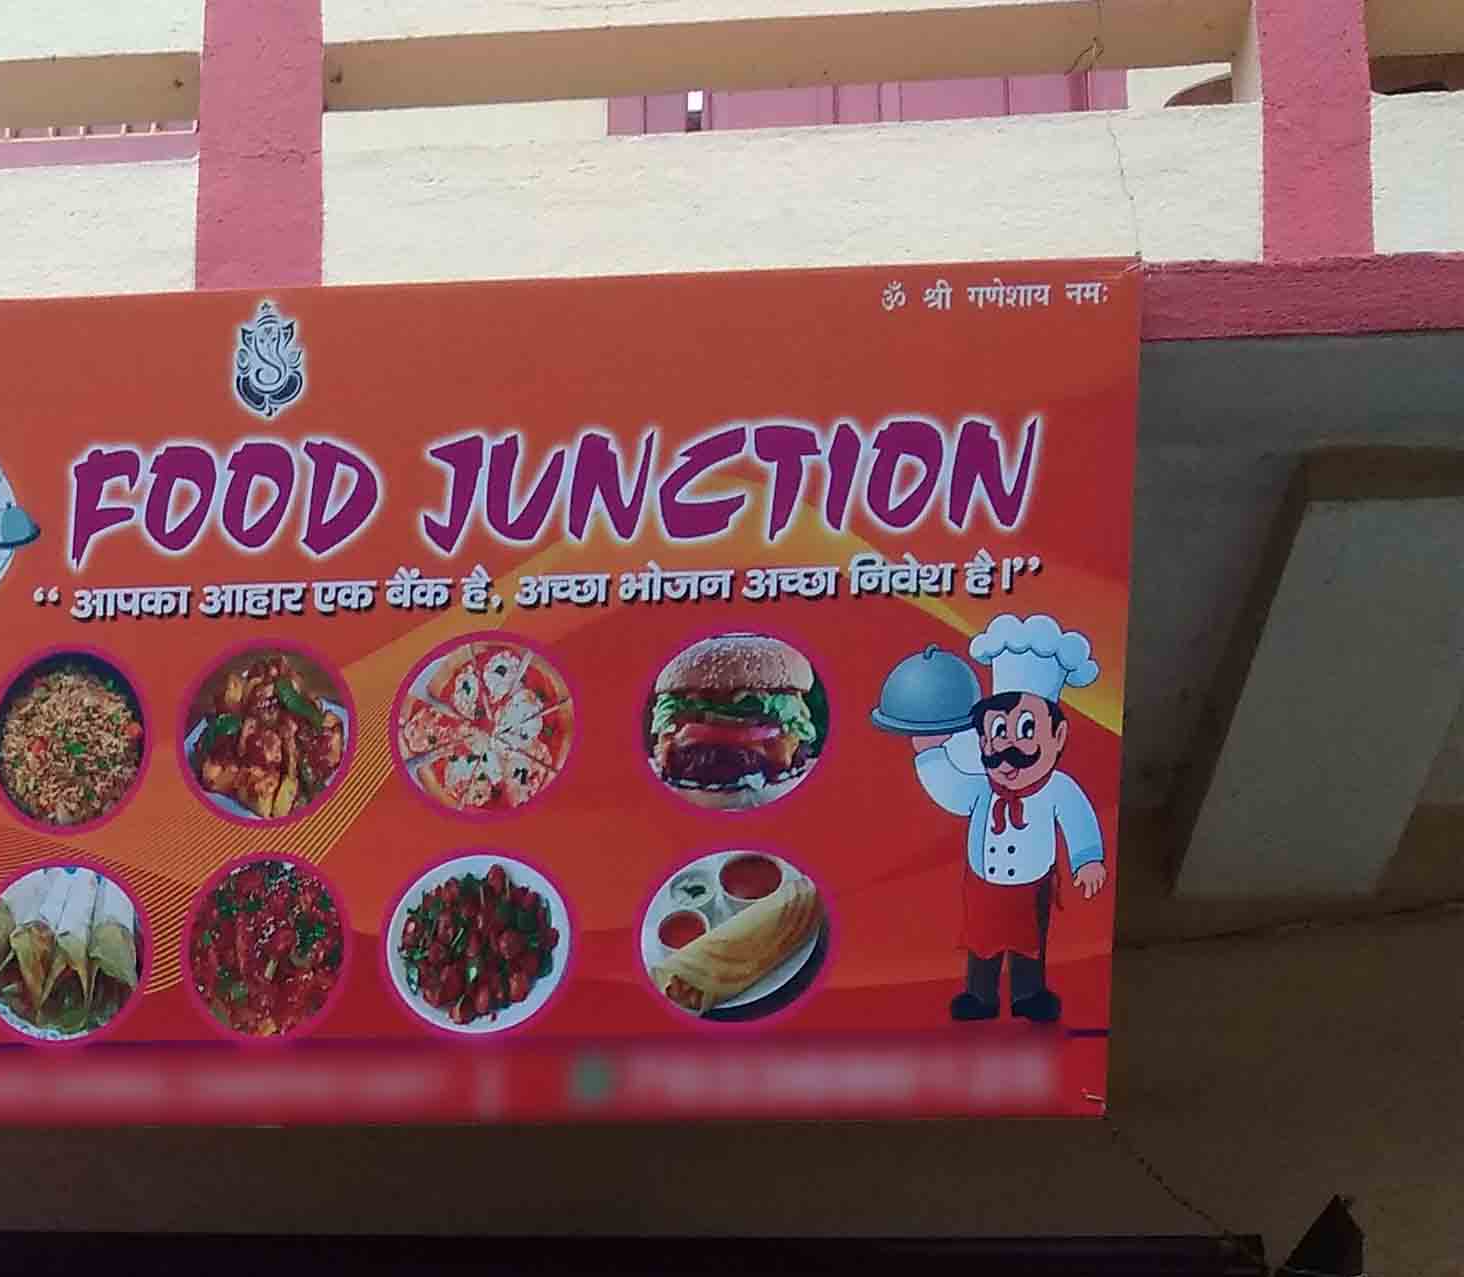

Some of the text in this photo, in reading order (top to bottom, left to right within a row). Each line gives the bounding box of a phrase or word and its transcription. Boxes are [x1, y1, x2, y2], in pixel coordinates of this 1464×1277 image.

[923, 279, 953, 311] श्री
[967, 277, 1051, 309] गणेशाय
[1064, 281, 1109, 305] नमः
[66, 432, 379, 572] FOOD
[420, 412, 1041, 556] JUNCTION
[71, 584, 191, 621] आपका
[199, 580, 307, 617] आहार
[313, 577, 377, 614] एक
[385, 566, 450, 610] बैंक
[515, 565, 608, 606] अच्छा
[617, 560, 733, 603] भोजन
[742, 563, 839, 601] अच्छा
[849, 550, 954, 598] निवेश
